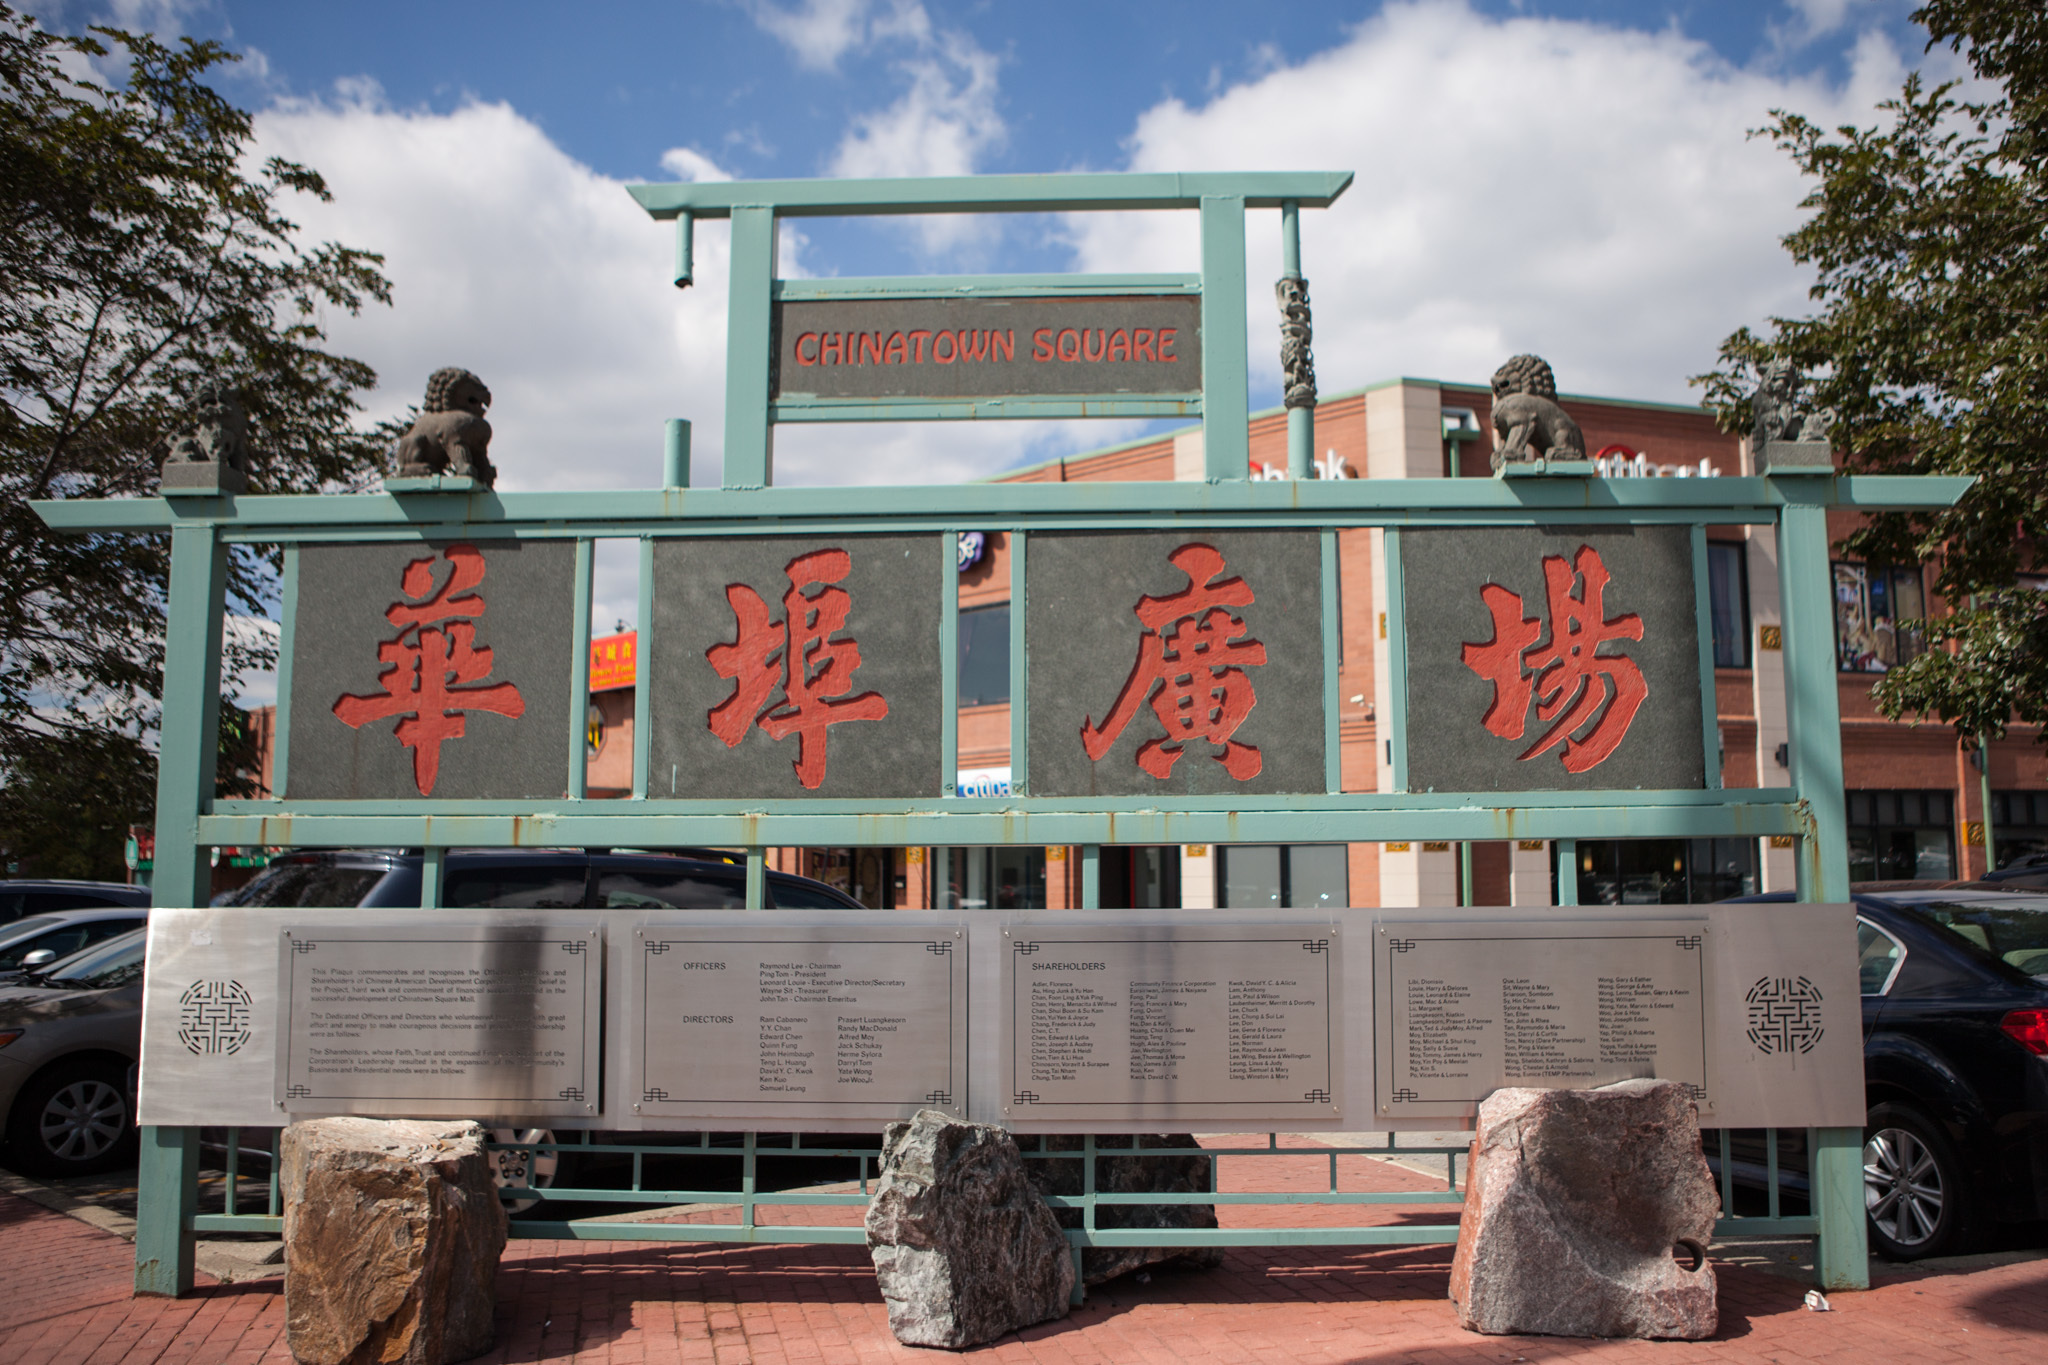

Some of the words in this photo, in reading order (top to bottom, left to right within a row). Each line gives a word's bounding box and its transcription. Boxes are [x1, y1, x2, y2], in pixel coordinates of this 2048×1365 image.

[795, 329, 1015, 366] CHINATOWN
[1032, 328, 1178, 363] SQUARE
[332, 543, 525, 796] 華
[706, 547, 889, 790] 埠
[1080, 542, 1268, 781] 廣
[1460, 543, 1648, 774] 場
[760, 963, 789, 971] Raymond
[1032, 963, 1106, 971] SHAREHOLDERS
[760, 971, 775, 979] Ping
[844, 980, 906, 988] Director/Secretary
[1184, 981, 1216, 989] Corporation
[760, 988, 783, 996] Wayne
[837, 1025, 858, 1033] Randy
[781, 1042, 798, 1051] Fung
[860, 1051, 882, 1059] Sylora
[760, 1060, 776, 1068] Teng
[785, 1060, 806, 1068] Huang
[853, 1068, 872, 1077] Wong
[785, 1085, 806, 1093] Leung
